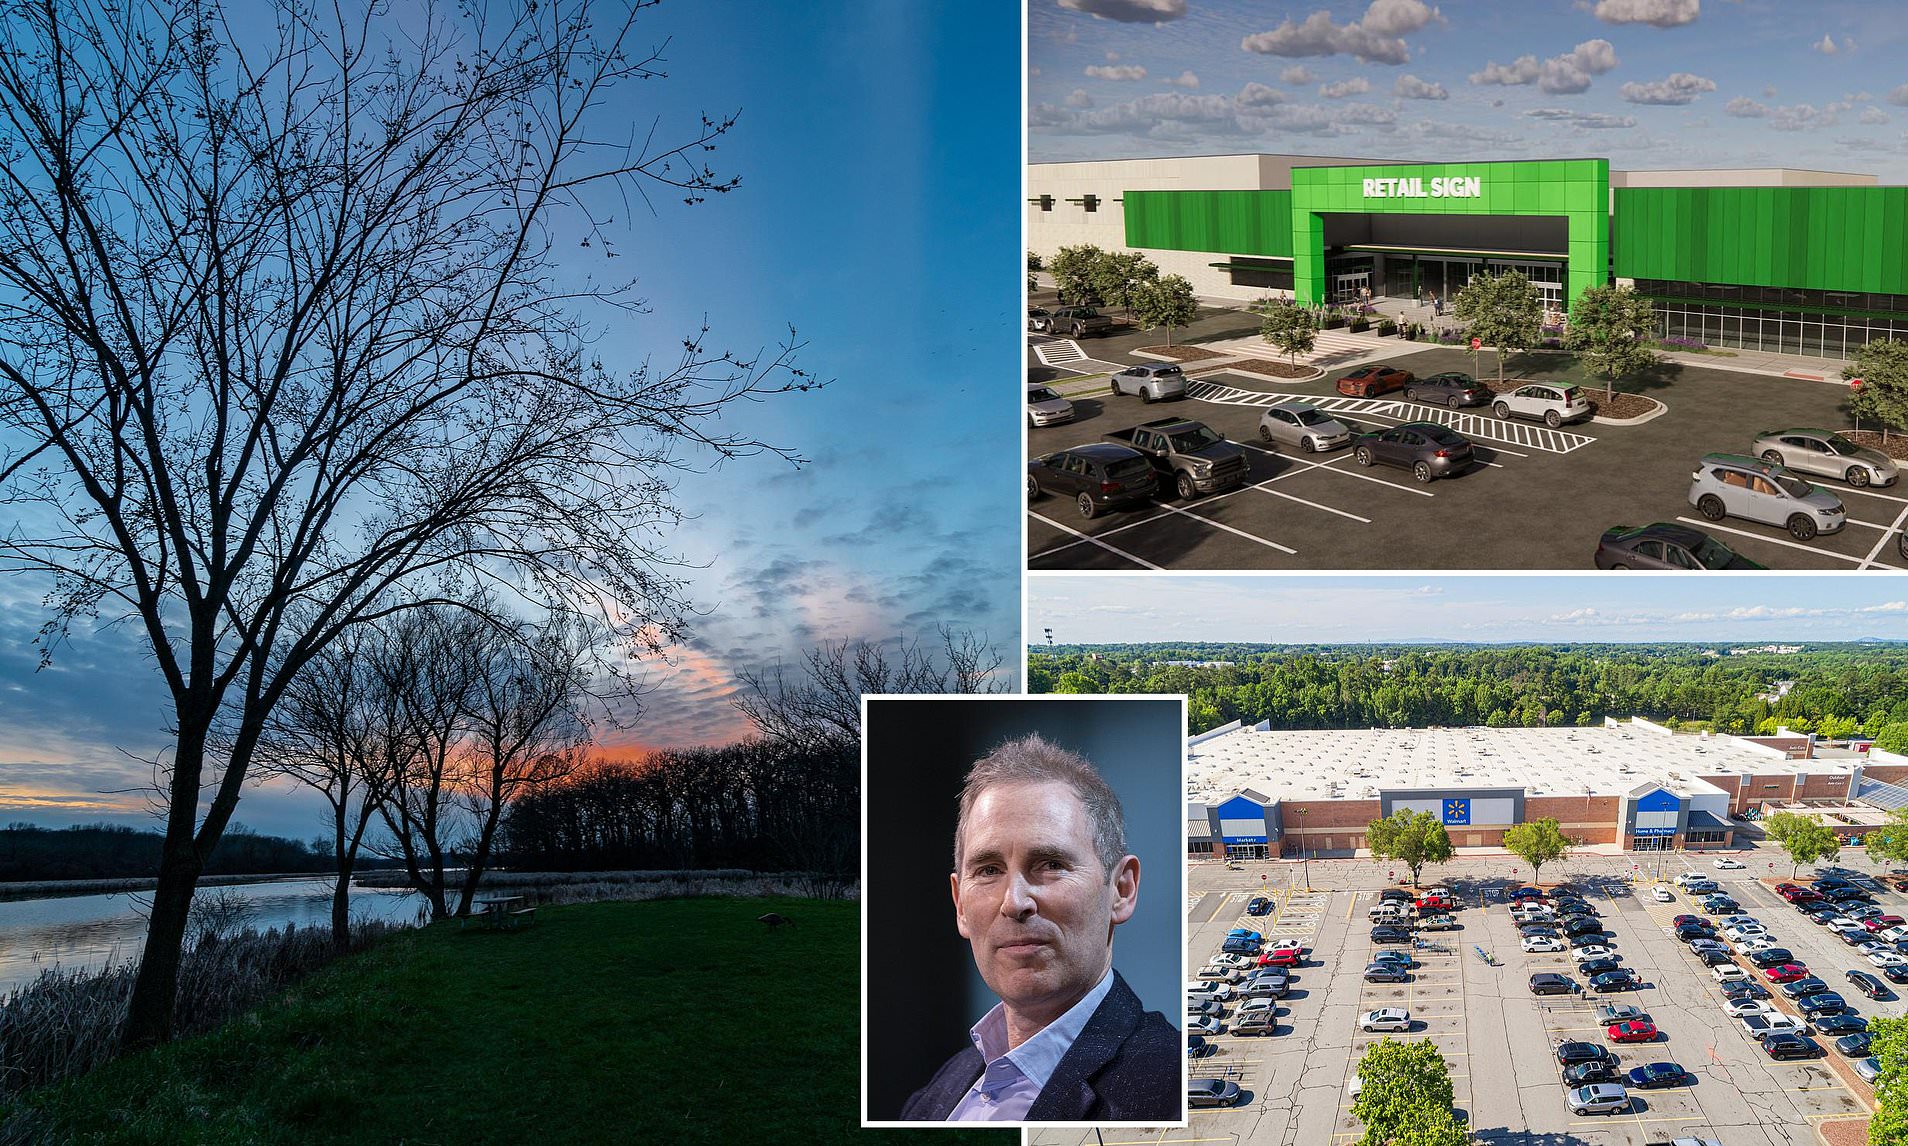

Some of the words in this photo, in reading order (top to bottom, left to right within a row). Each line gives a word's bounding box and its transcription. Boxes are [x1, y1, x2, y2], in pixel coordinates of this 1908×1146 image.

[1363, 177, 1428, 198] RETAIL
[1430, 176, 1480, 198] SIGN
[1484, 889, 1500, 897] STOP
